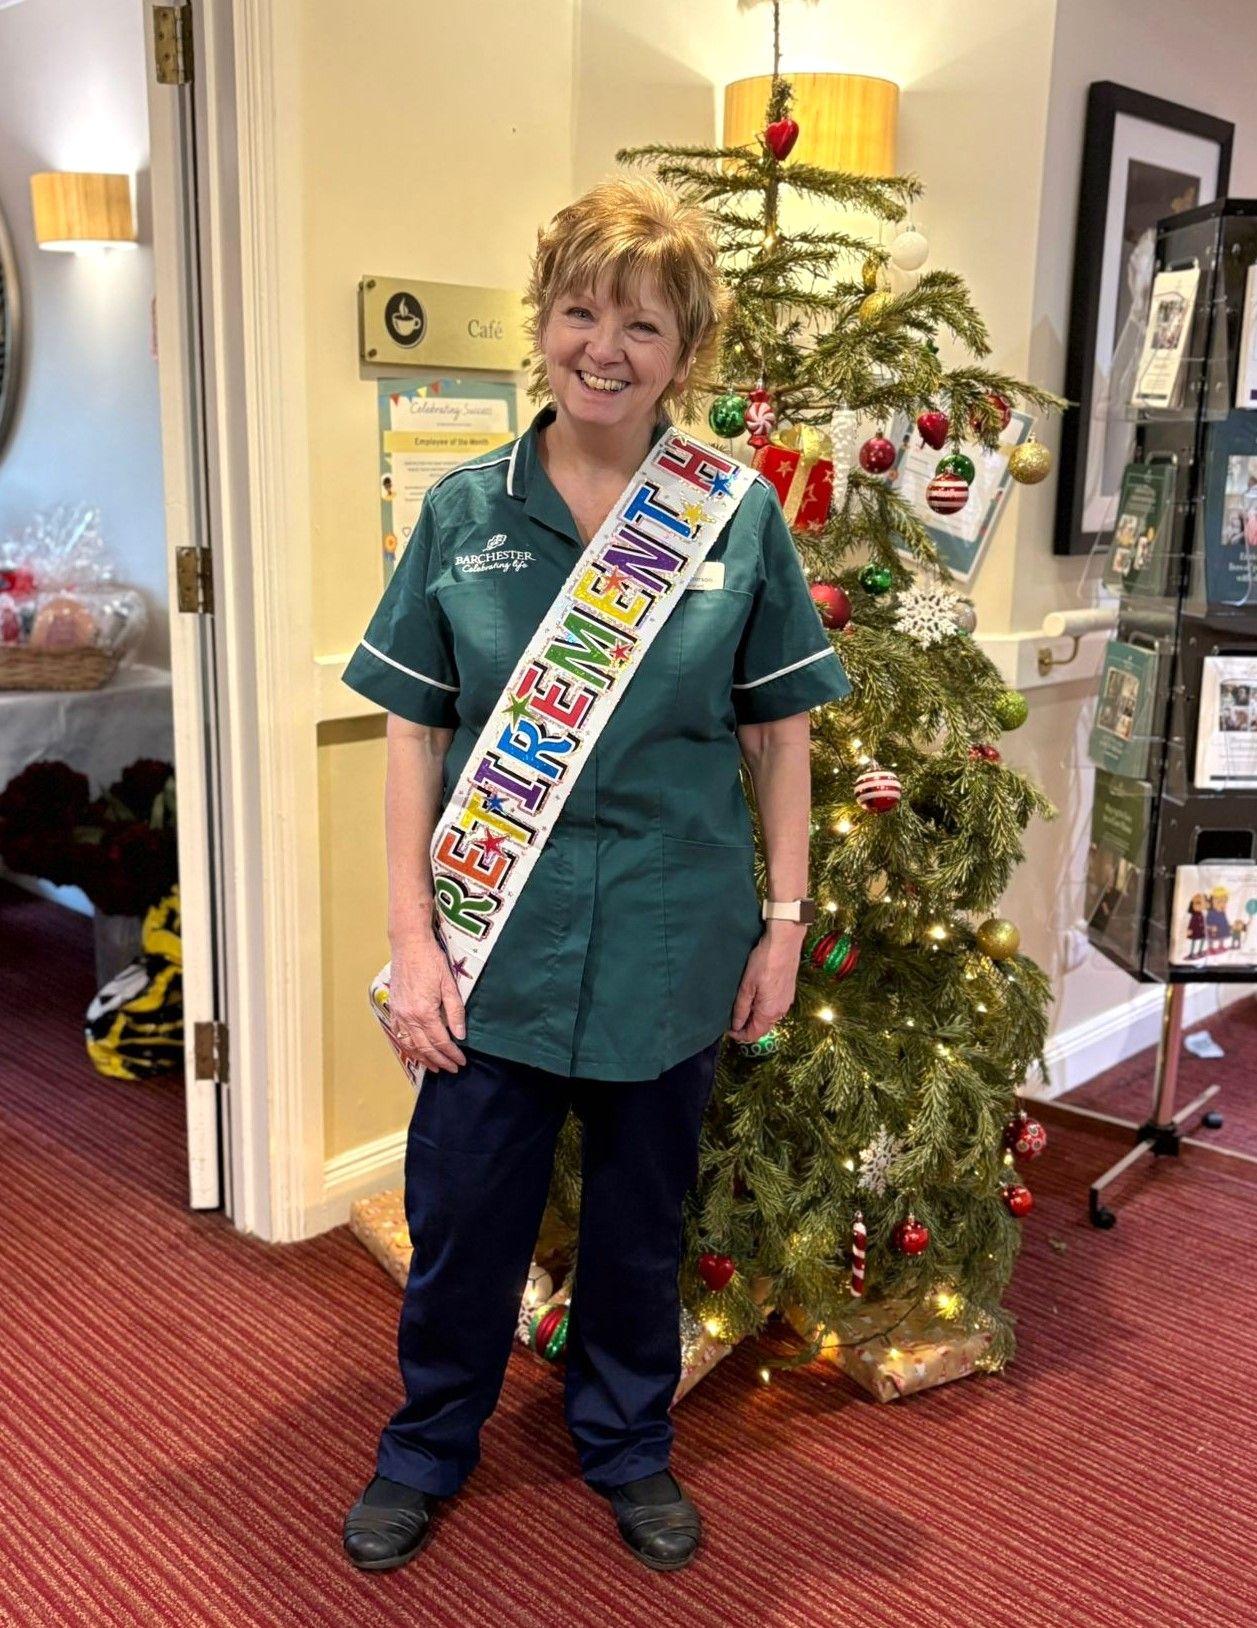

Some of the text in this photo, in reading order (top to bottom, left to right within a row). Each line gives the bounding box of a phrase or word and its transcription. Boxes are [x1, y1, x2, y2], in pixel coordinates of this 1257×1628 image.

[468, 318, 503, 340] Café
[410, 400, 460, 420] Celebrating
[414, 437, 490, 446] Employee of the Month
[455, 550, 536, 565] BARCHESTER
[461, 560, 529, 573] Celebrating life
[434, 479, 702, 940] RETIREMENT
